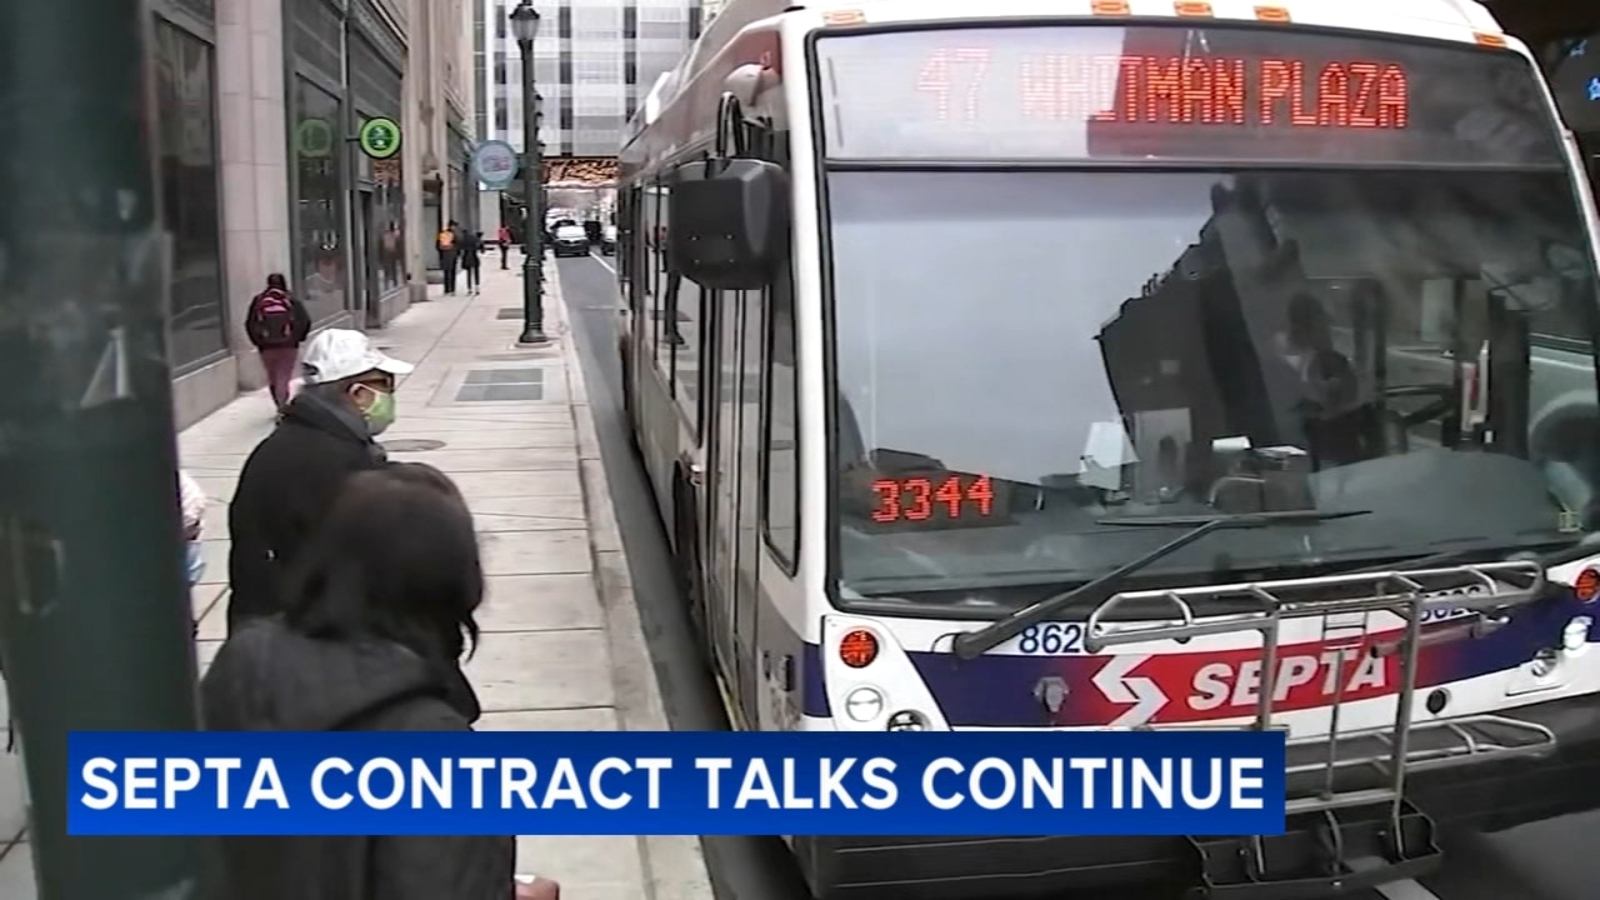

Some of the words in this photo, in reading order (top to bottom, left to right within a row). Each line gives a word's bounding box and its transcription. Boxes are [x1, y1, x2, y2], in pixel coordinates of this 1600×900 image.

[916, 47, 989, 124] 47
[1020, 54, 1245, 124] WHITMAN
[1259, 60, 1408, 128] PLAZA
[871, 474, 994, 522] 3344
[1019, 624, 1102, 654] 862
[1187, 649, 1387, 711] SEPTA
